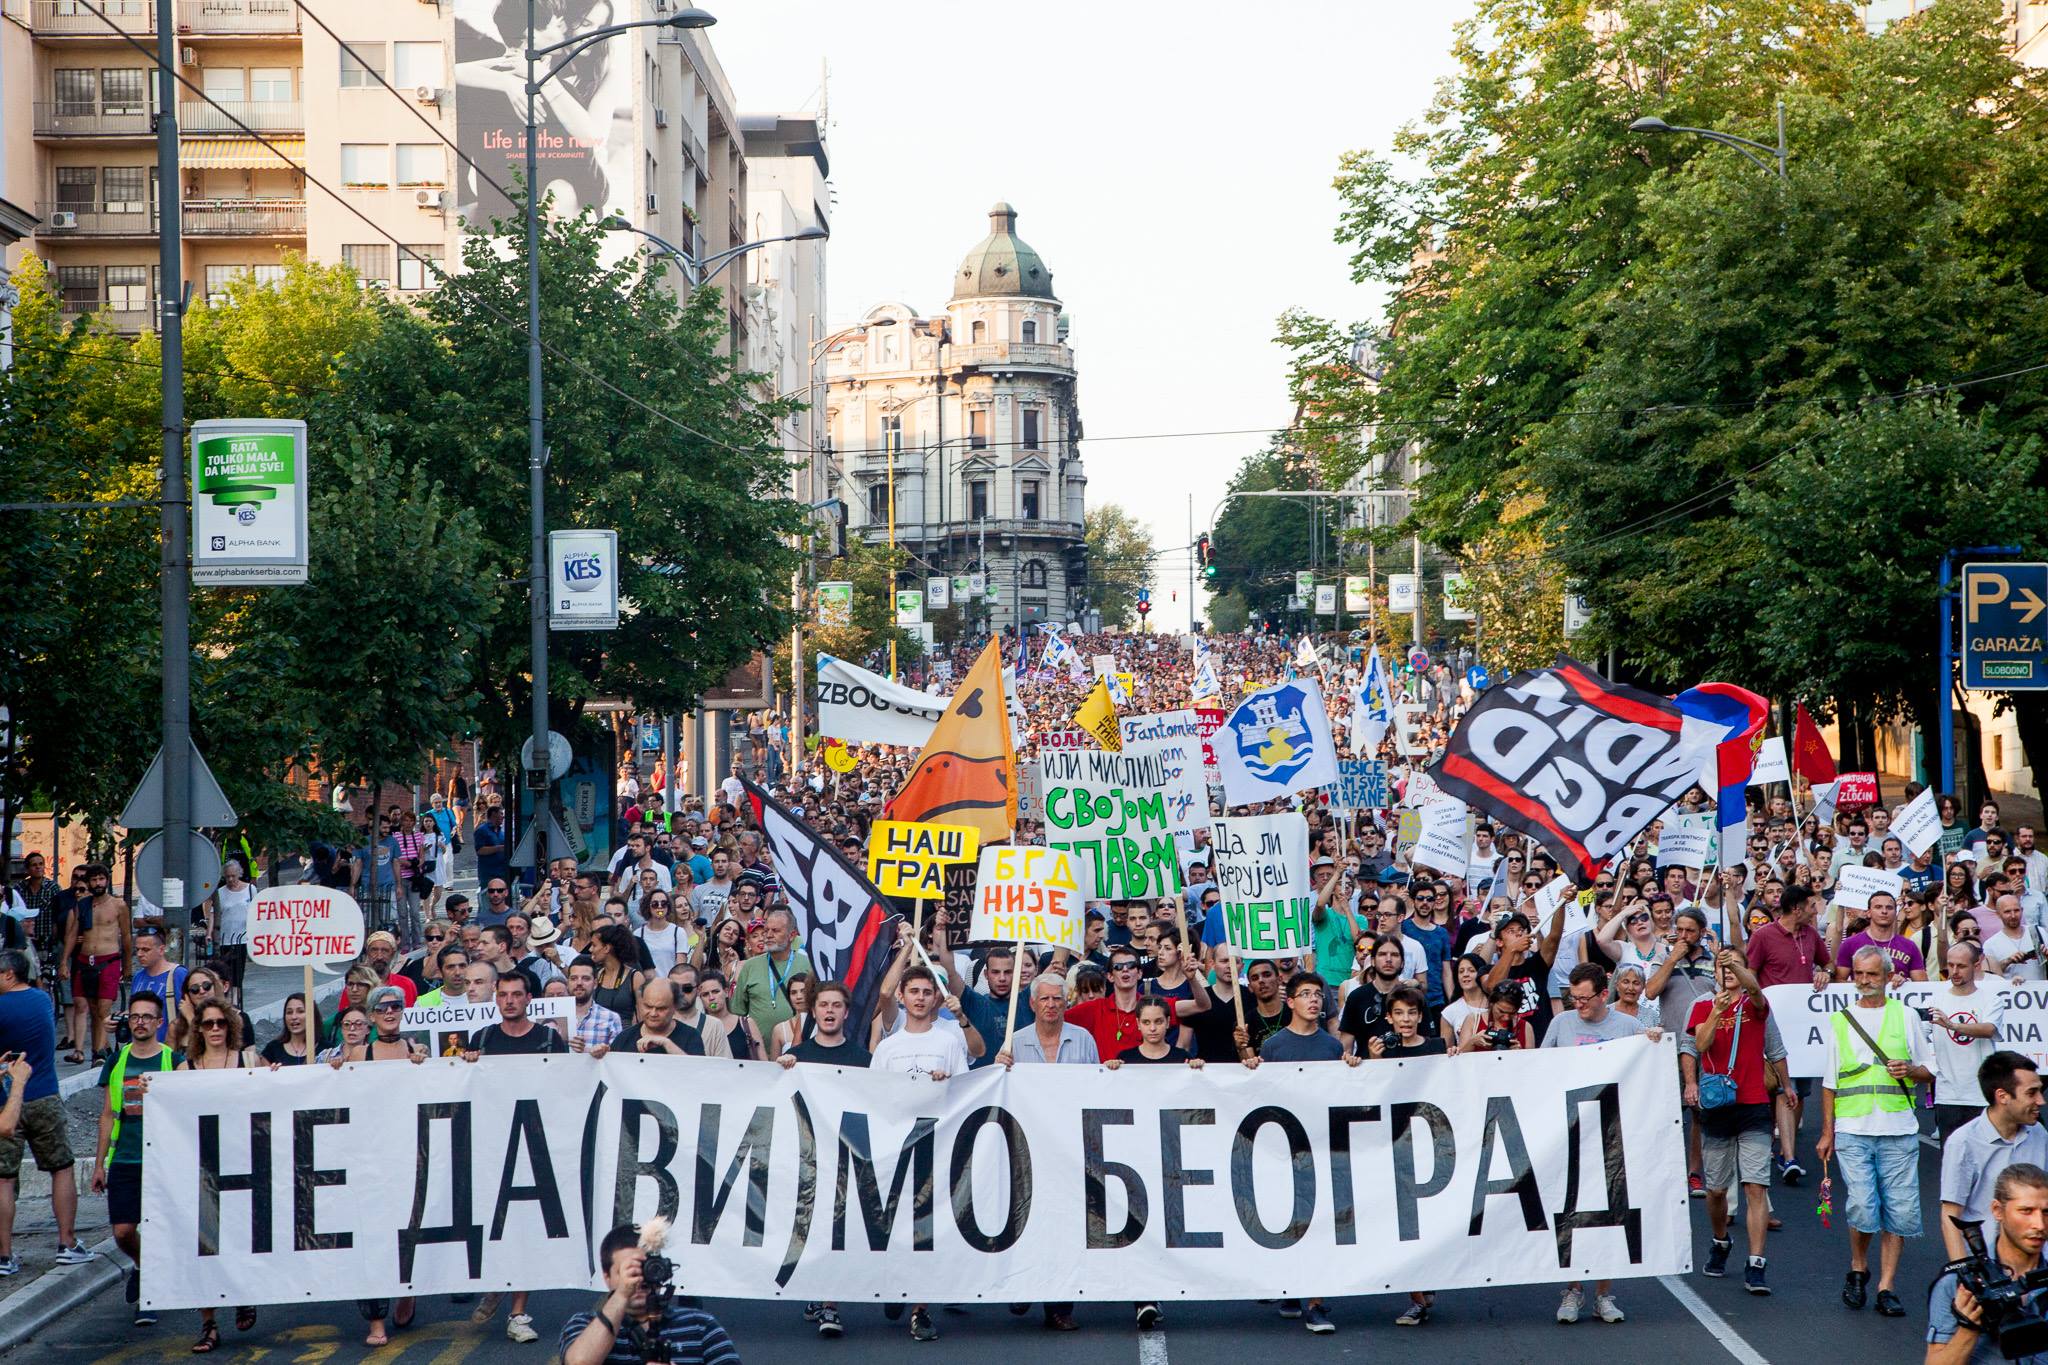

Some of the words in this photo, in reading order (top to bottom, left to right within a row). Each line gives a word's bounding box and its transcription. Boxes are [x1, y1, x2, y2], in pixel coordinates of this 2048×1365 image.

[483, 129, 513, 149] Life
[538, 128, 564, 149] the
[231, 442, 259, 453] RATA
[205, 466, 219, 477] DA
[220, 464, 258, 475] MENJA
[260, 461, 285, 473] SVE!
[207, 454, 244, 466] TOLIKO
[246, 452, 278, 463] MALA
[563, 551, 590, 561] ALPHA
[193, 567, 302, 578] www.alphabankserbia.com
[1968, 572, 2010, 624] P
[1972, 635, 2043, 652] GARAŽA
[1985, 665, 2029, 676] SLOBODNO
[818, 681, 890, 711] ZBOG
[1124, 714, 1201, 744] Fantomke
[1043, 752, 1083, 782] ИЛИ
[1089, 750, 1168, 789] МИСЛИШ
[1338, 760, 1386, 777] USICE
[1359, 776, 1386, 791] SVE
[1045, 786, 1168, 836] СВОЈОМ
[887, 827, 964, 858] НАШ
[1215, 822, 1247, 860] Да
[1256, 832, 1282, 856] ли
[874, 858, 944, 892] ГРА
[995, 849, 1078, 891] БГД
[1218, 860, 1289, 900] верујеш
[257, 899, 332, 921] FANTOMI
[983, 881, 1069, 917] НИЈЕ
[291, 919, 308, 935] IZ
[253, 932, 356, 957] SKUPŠTINE
[404, 1006, 476, 1025] VUČIĆEV
[481, 1006, 496, 1020] IV
[1807, 1023, 1824, 1045] A
[1999, 1023, 2043, 1043] NA
[198, 1107, 354, 1257] НЕ
[398, 1079, 1033, 1288] ДА(ВИ)МО
[1082, 1083, 1642, 1268] БЕОГРАД
